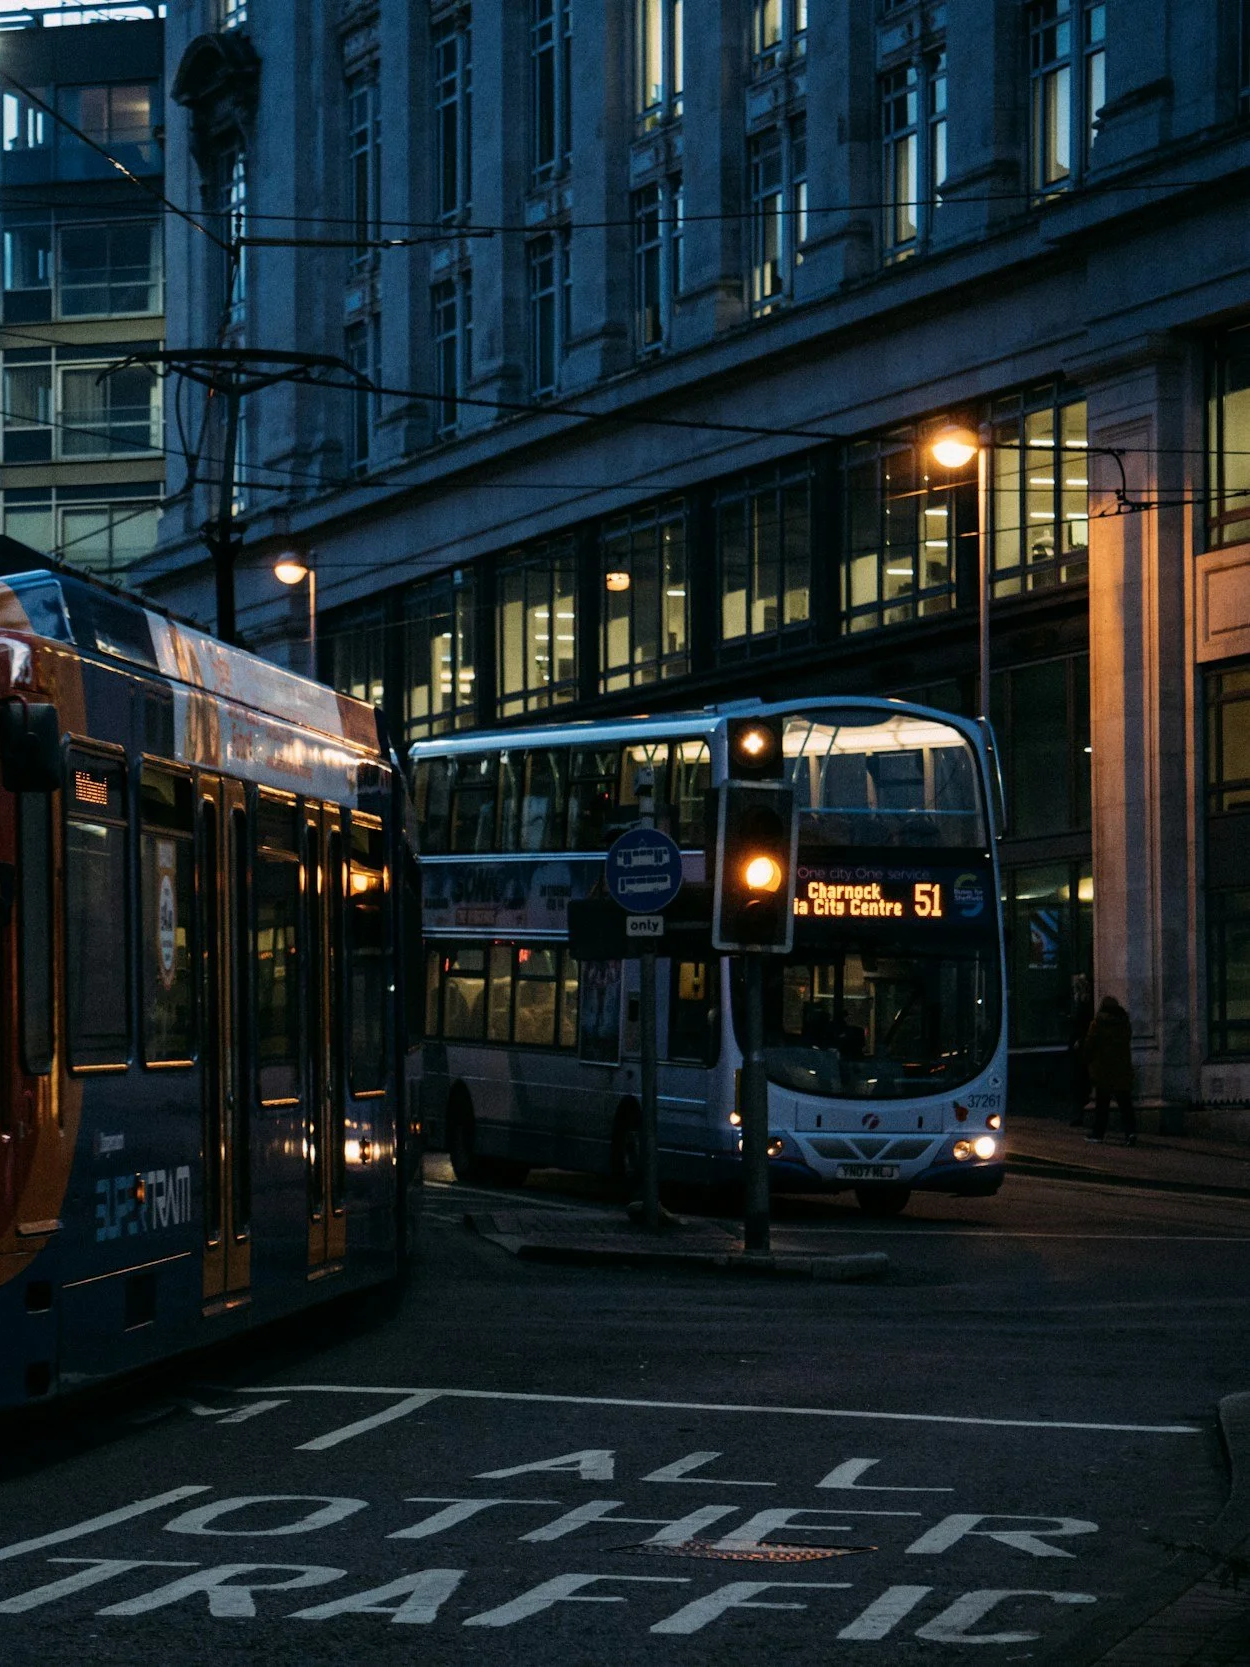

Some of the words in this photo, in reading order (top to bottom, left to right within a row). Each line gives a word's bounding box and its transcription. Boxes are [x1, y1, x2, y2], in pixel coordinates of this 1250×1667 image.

[798, 867, 825, 879] One
[855, 867, 883, 879] One
[807, 881, 882, 900] Charnock
[913, 883, 943, 917] 51
[793, 897, 809, 915] ia
[813, 898, 845, 916] City
[850, 898, 903, 917] Centre
[630, 920, 659, 933] only
[967, 1094, 1001, 1108] 37261
[472, 1449, 955, 1492] ALL
[162, 1495, 1100, 1559] OTHER
